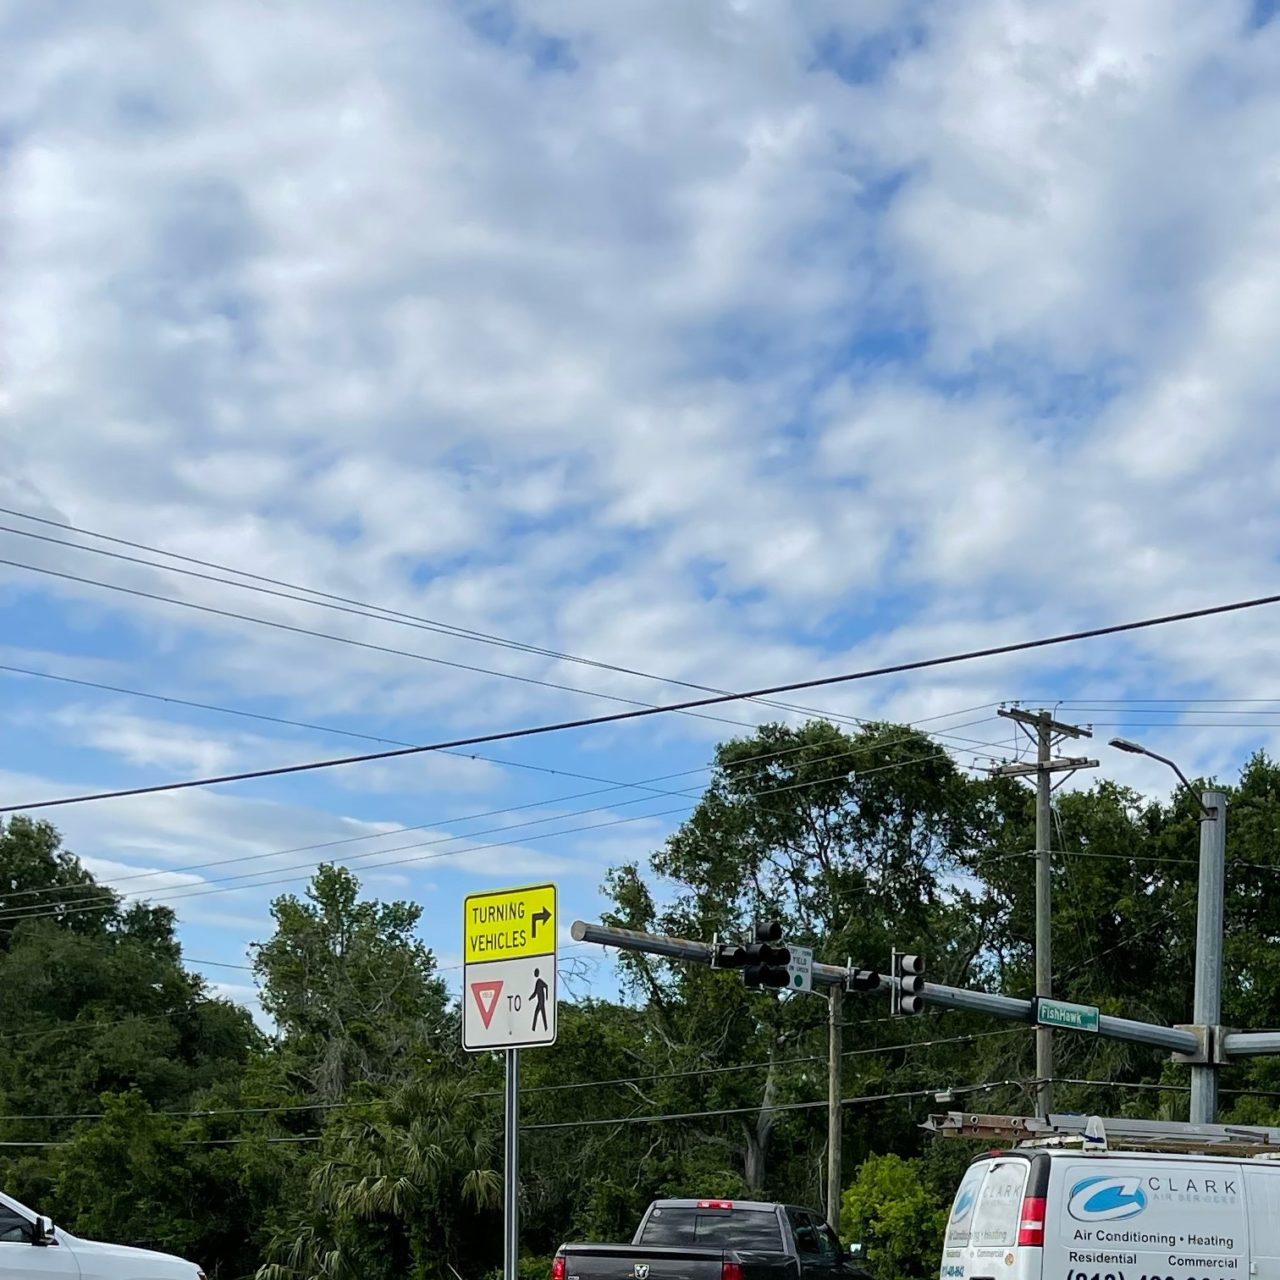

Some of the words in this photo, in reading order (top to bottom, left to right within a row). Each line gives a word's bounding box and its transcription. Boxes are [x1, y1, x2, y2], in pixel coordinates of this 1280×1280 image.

[472, 902, 525, 924] TURNING
[470, 930, 527, 952] VEHICLES
[506, 994, 522, 1012] TO
[1041, 1005, 1082, 1025] FishHawk
[1148, 1176, 1237, 1195] CLARK
[1073, 1229, 1093, 1242] Air
[1096, 1229, 1176, 1247] Conditioning
[1187, 1234, 1234, 1249] Heating
[1069, 1251, 1137, 1265] Residential
[1168, 1255, 1238, 1269] Commercial
